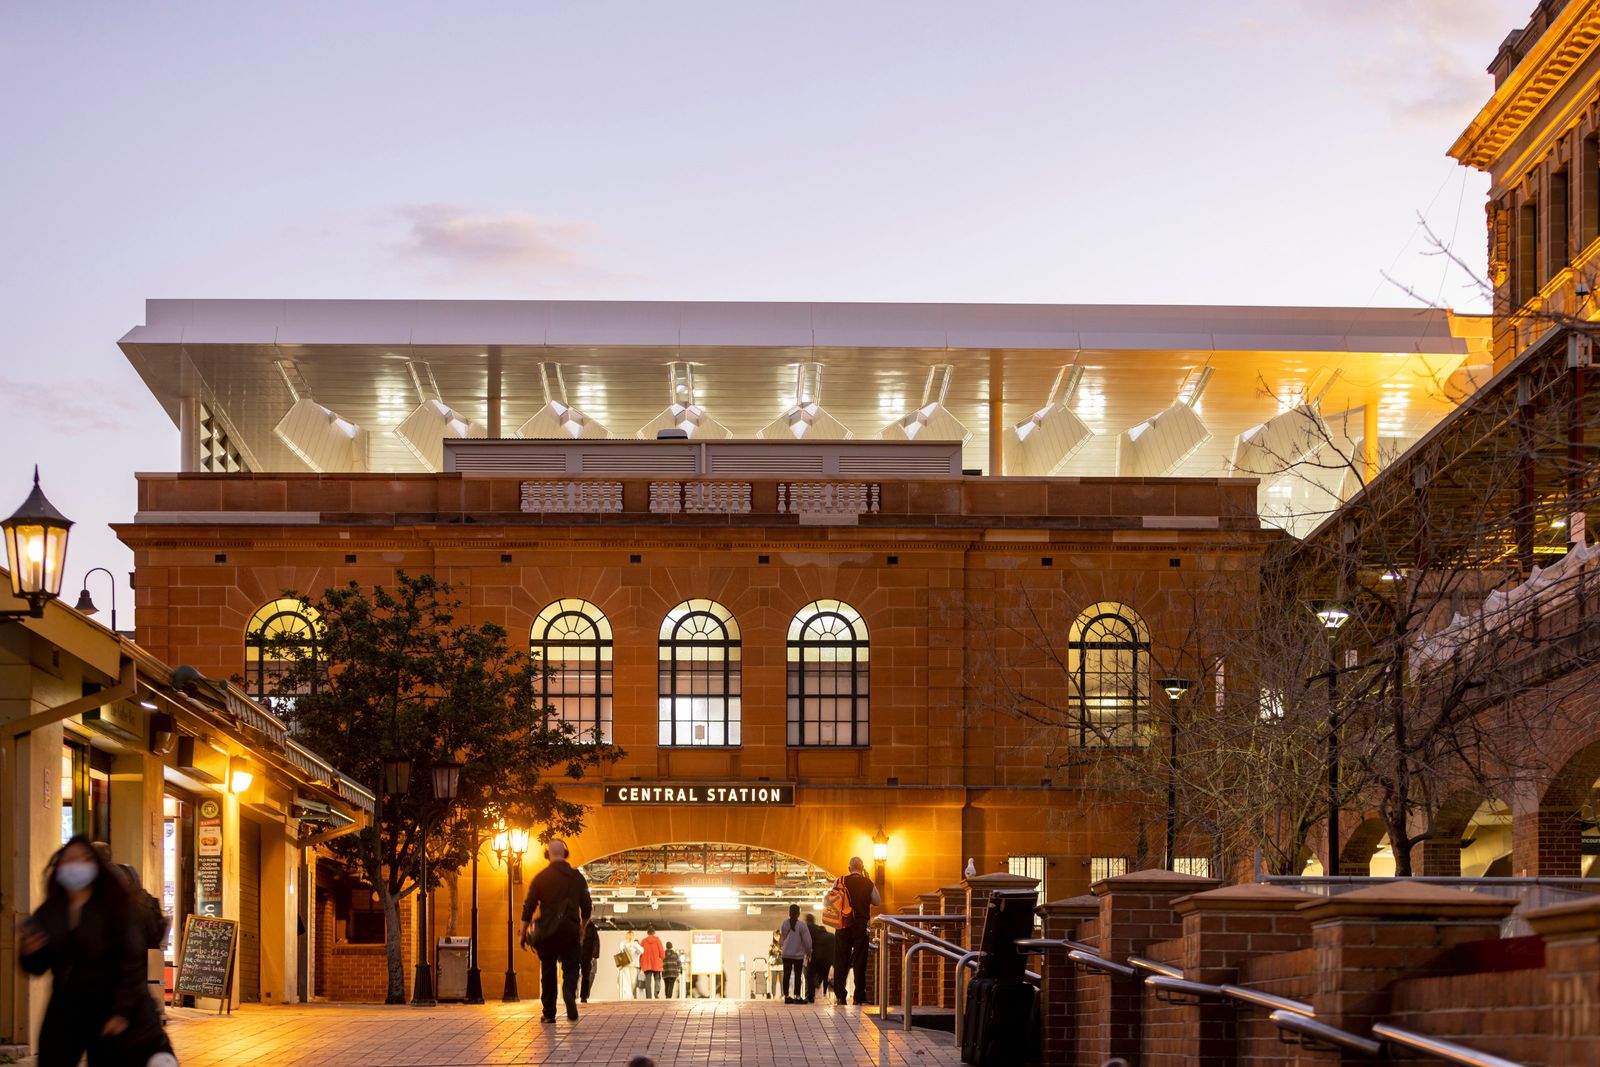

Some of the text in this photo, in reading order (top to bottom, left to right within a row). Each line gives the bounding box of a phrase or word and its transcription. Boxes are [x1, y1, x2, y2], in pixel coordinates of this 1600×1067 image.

[618, 788, 780, 802] CENTRAL STATION
[195, 920, 226, 929] COFFEE
